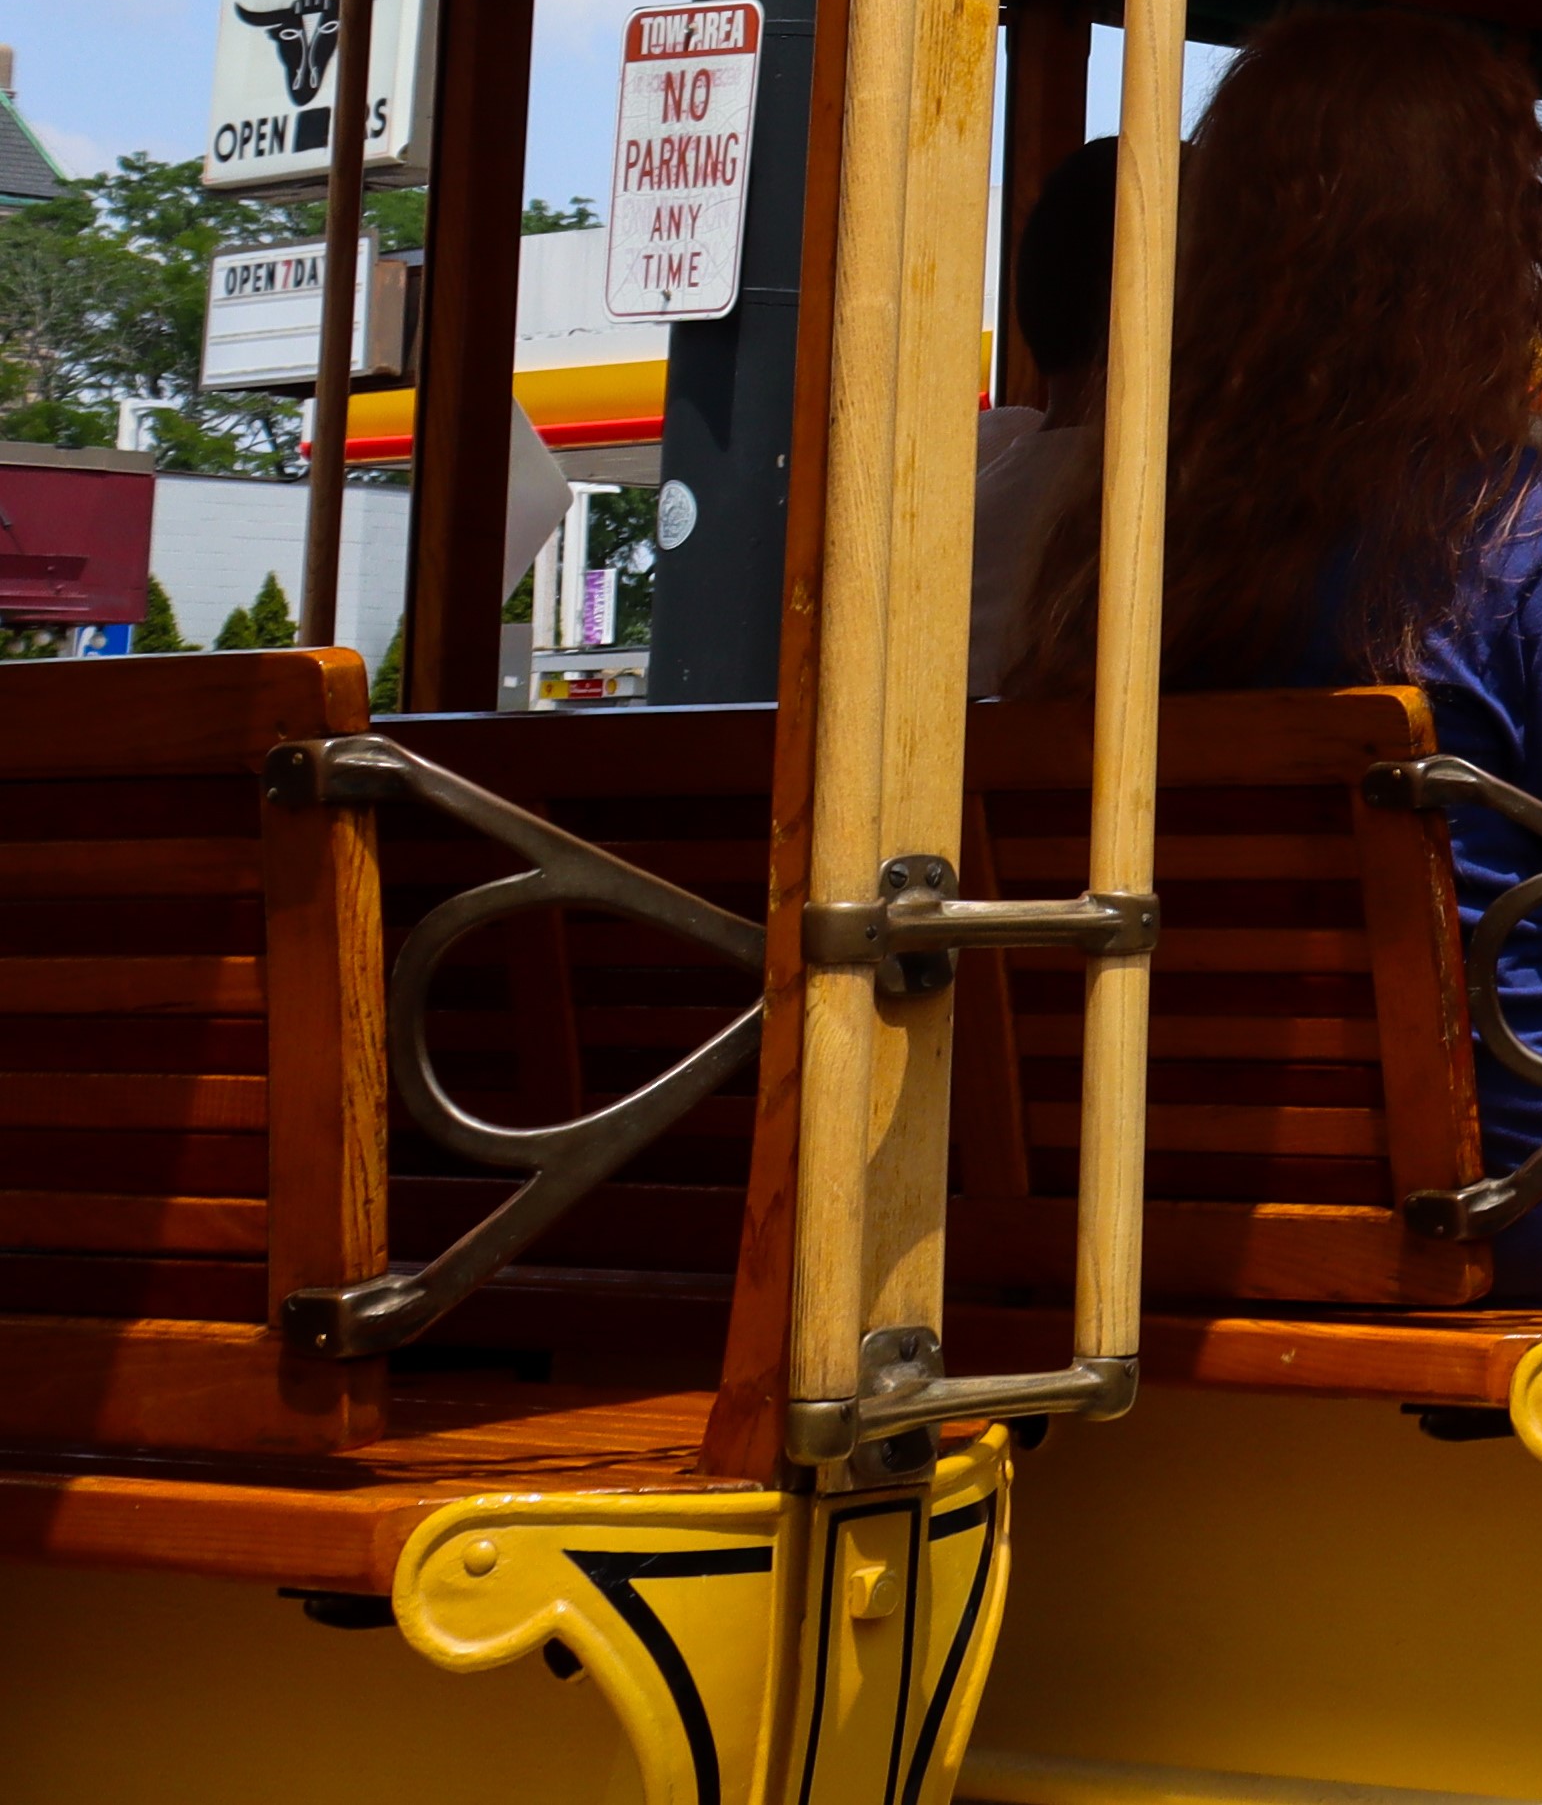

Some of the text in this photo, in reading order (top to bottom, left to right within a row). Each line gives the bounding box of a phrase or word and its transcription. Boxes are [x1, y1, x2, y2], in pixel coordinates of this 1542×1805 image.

[661, 67, 711, 124] NO
[213, 113, 290, 164] OPEN
[622, 131, 740, 192] PARKING
[649, 203, 703, 242] ANY
[224, 257, 322, 296] OPEN 7 DA
[642, 251, 702, 290] TIME
